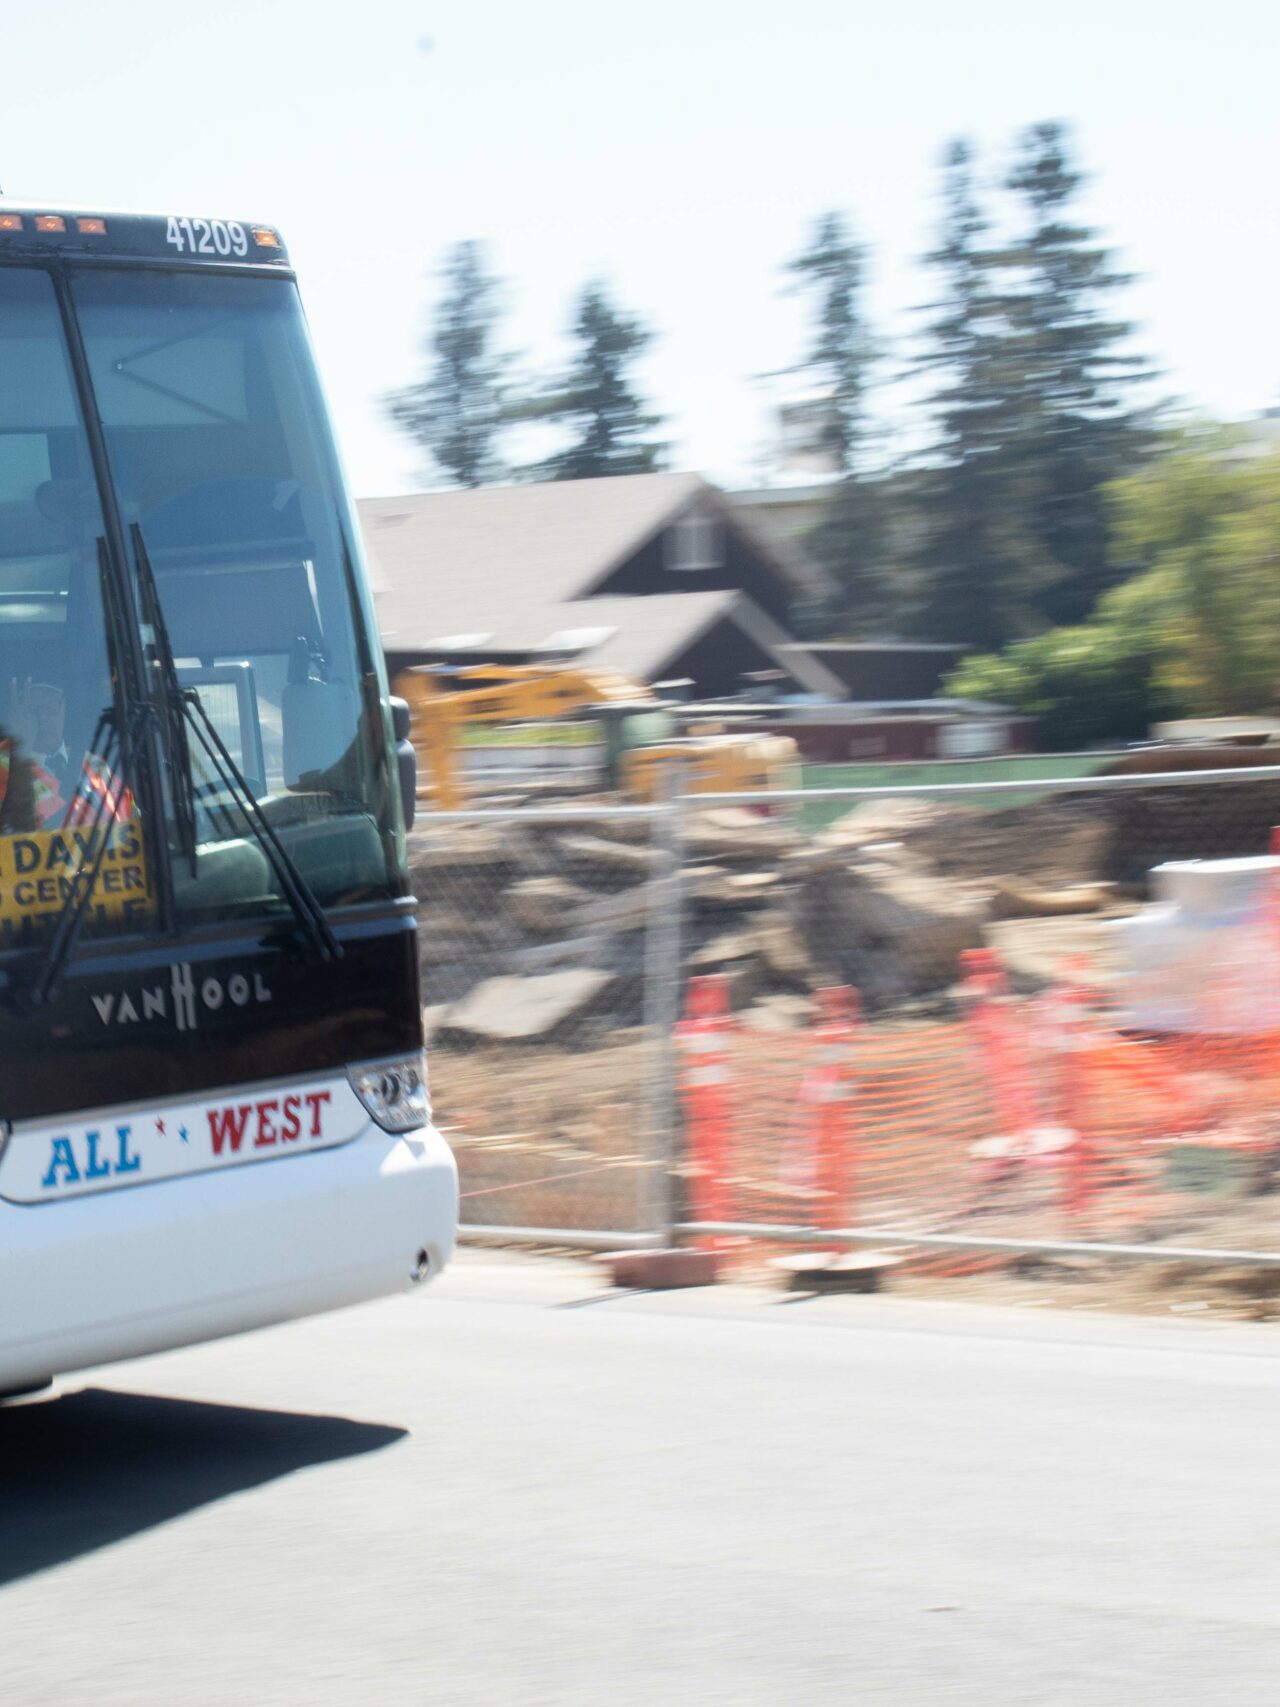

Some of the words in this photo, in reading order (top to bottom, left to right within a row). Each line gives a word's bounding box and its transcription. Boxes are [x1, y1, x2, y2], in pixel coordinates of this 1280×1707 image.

[166, 216, 248, 256] 41209
[13, 823, 141, 876] DAVIS
[41, 1125, 141, 1187] ALL
[206, 1091, 331, 1157] WEST
